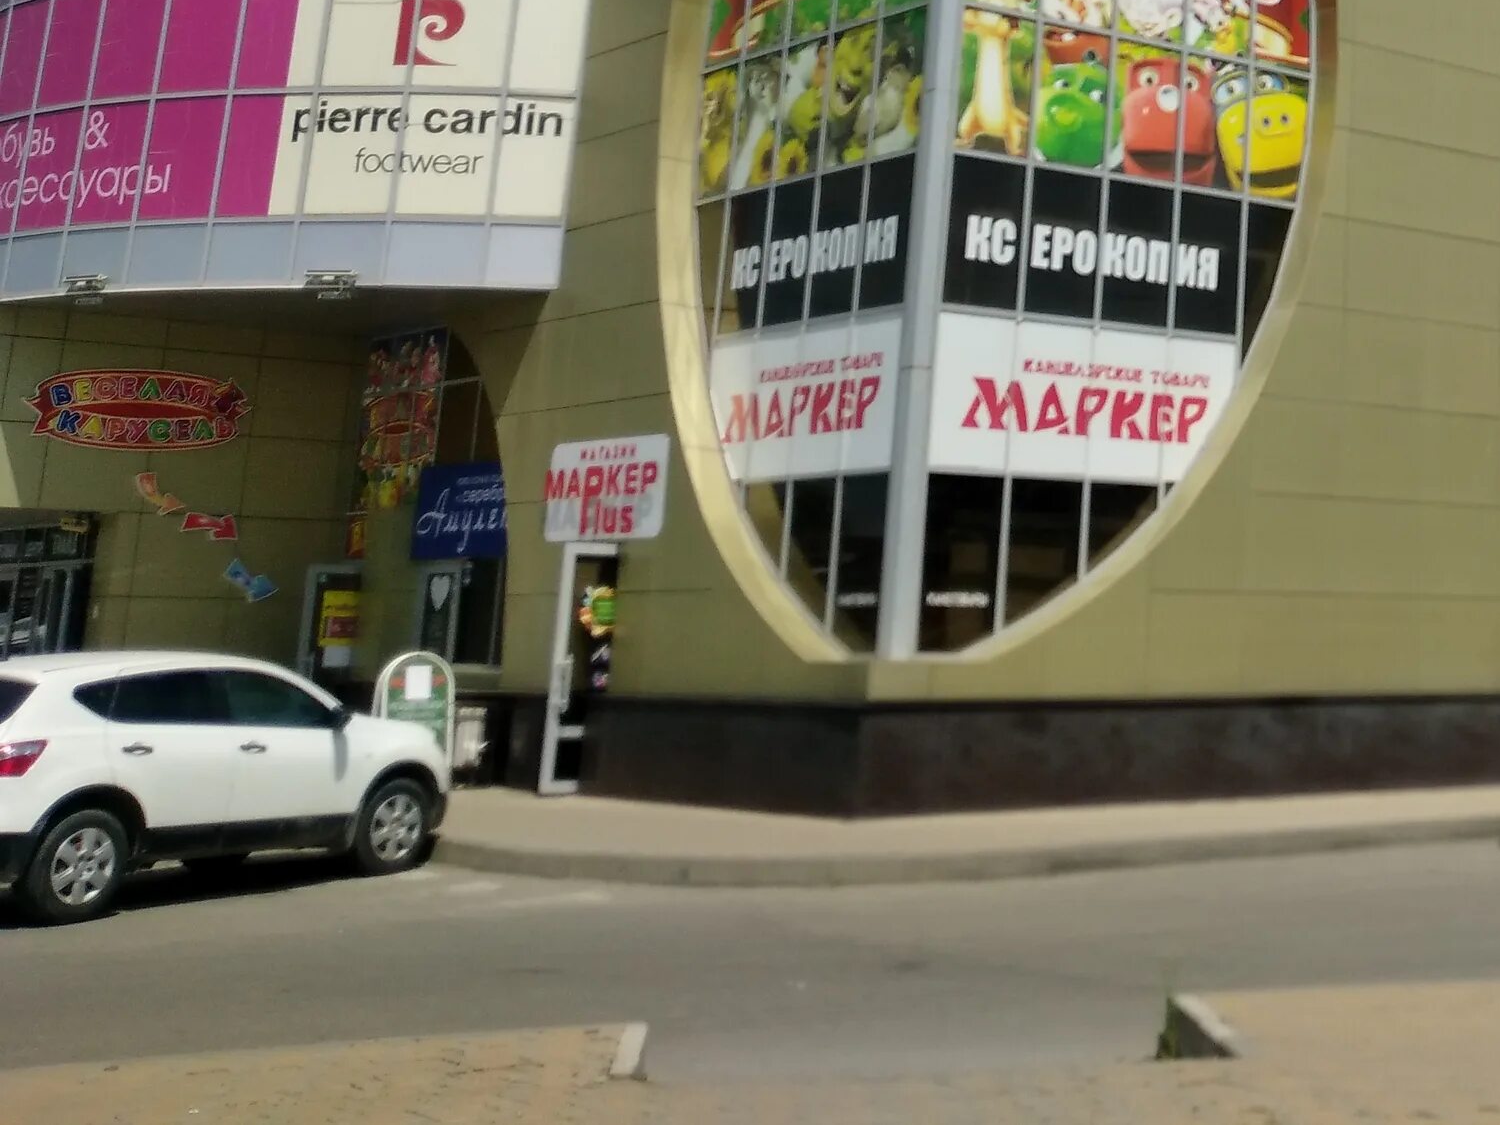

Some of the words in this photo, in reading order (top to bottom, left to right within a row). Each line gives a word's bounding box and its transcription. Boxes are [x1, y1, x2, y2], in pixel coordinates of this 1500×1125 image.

[84, 110, 110, 150] &
[291, 100, 409, 142] pierre
[424, 102, 563, 136] cardin
[354, 147, 485, 175] footwear
[964, 214, 1221, 292] КСЕРОКОПИЯ
[51, 376, 210, 407] ВЕСЕЛАЯ
[721, 376, 881, 444] МАРКЕР
[961, 376, 1209, 443] МАРКЕР
[55, 409, 235, 443] КАРУСЕЛЬ
[544, 460, 658, 505] МАРКЕР
